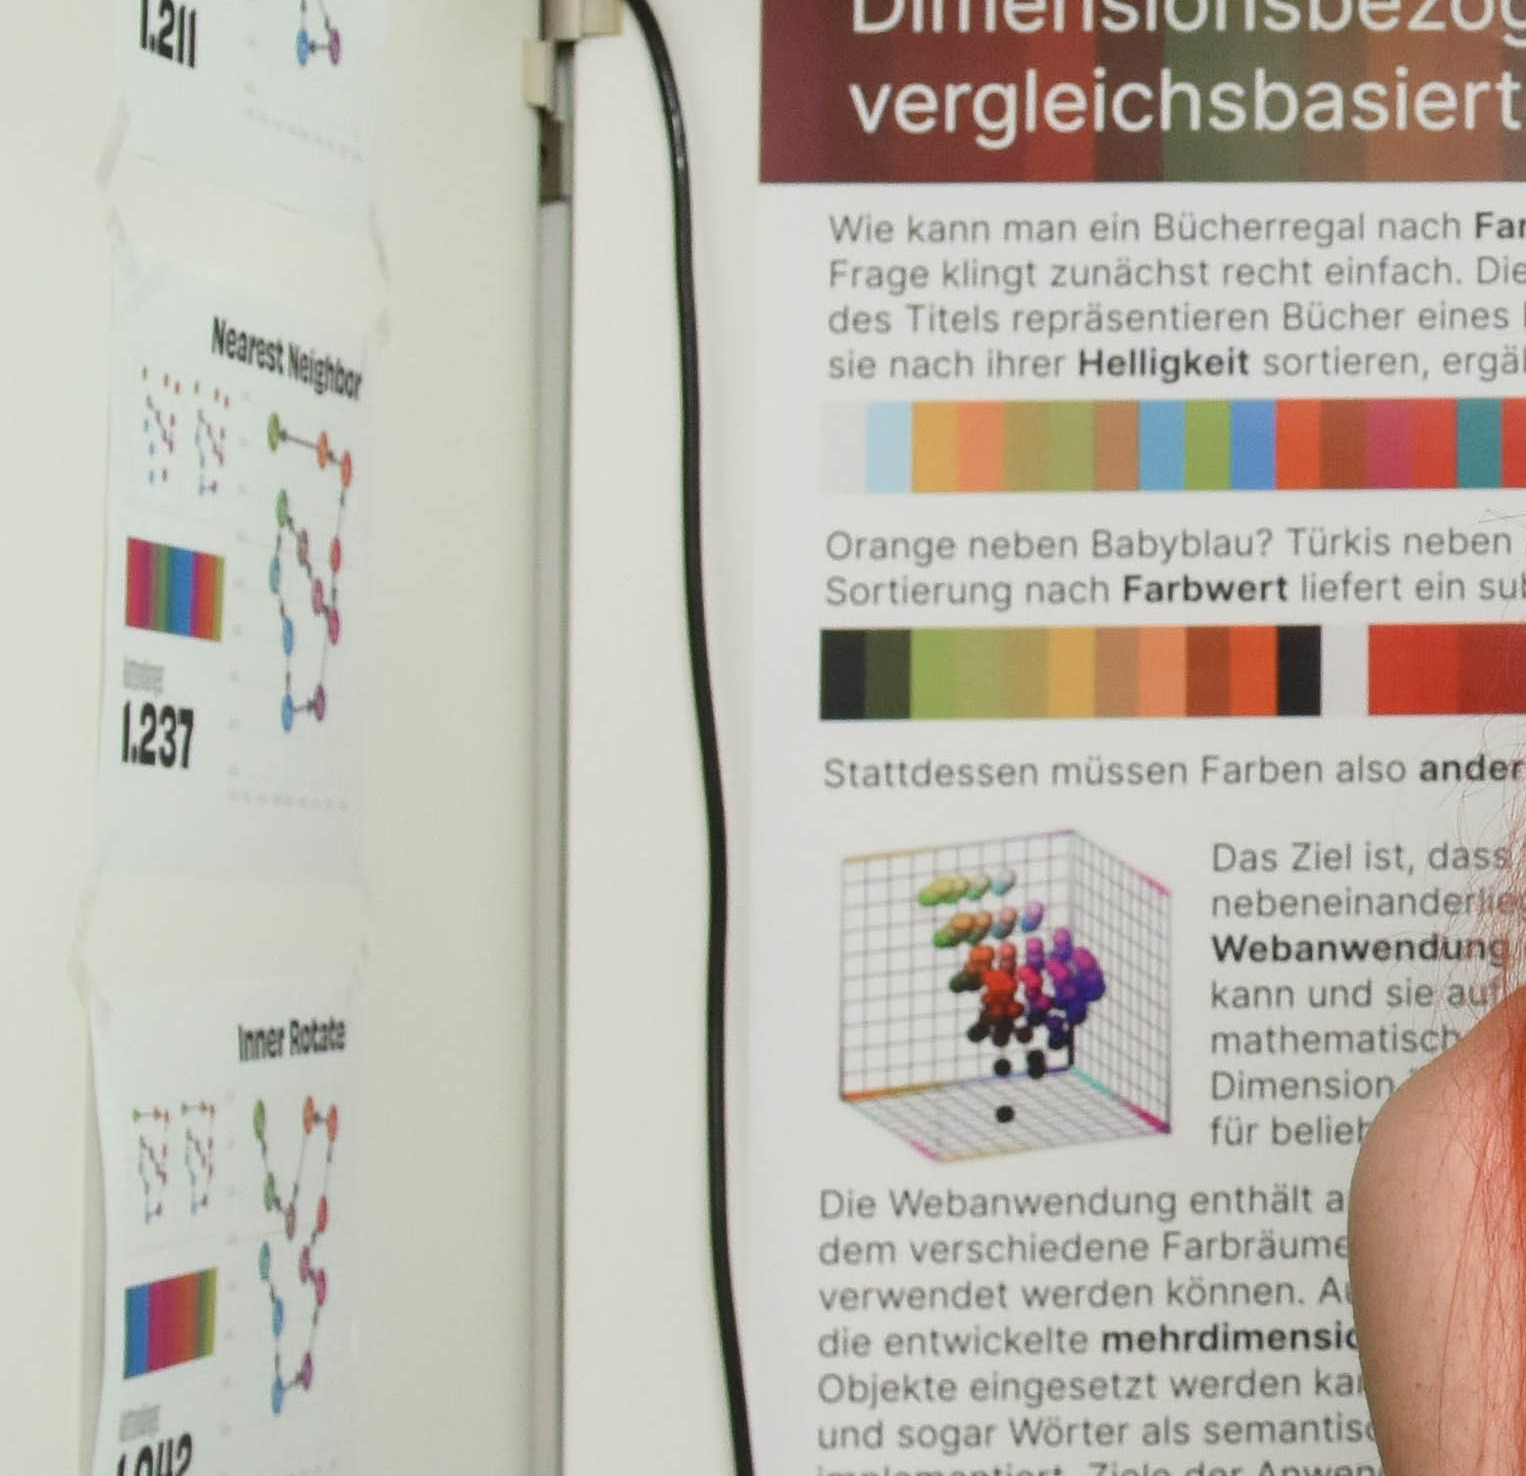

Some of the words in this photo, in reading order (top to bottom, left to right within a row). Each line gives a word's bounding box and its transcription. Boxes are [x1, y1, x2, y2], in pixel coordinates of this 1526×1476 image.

[829, 215, 894, 243] Wie
[907, 216, 990, 242] kann
[1004, 219, 1076, 243] man
[1089, 219, 1140, 241] ein
[1154, 212, 1364, 248] Bücherregal
[1378, 212, 1461, 240] nach
[829, 259, 930, 297] Frage
[942, 260, 1036, 296] klingt
[1050, 258, 1208, 289] zunächst
[1223, 257, 1312, 286] recht
[1325, 255, 1462, 286] einfach.
[828, 305, 892, 334] des
[906, 303, 1000, 334] Titels
[1012, 301, 1269, 339] repräsentieren
[1283, 301, 1405, 332] Bücher
[1417, 301, 1509, 331] eines
[211, 315, 284, 374] Nearest
[288, 348, 363, 401] Neighbor
[830, 354, 876, 378] sie
[890, 352, 973, 377] nach
[988, 352, 1063, 377] ihrer
[1079, 346, 1249, 385] Helligkeit
[1264, 350, 1428, 378] sortieren,
[826, 530, 956, 568] Orange
[969, 532, 1078, 560] neben
[1092, 527, 1273, 565] Babyblau?
[1287, 526, 1391, 558] Türkis
[1404, 527, 1512, 557] neben
[827, 580, 1011, 610] Sortierung
[1026, 577, 1109, 603] nach
[1123, 573, 1288, 603] Farbwert
[1302, 572, 1401, 601] liefert
[1415, 578, 1465, 601] ein
[825, 760, 1038, 787] Stattdessen
[1052, 762, 1187, 785] müssen
[1202, 755, 1323, 784] Farben
[1336, 755, 1406, 783] also
[1213, 842, 1278, 873] Das
[1291, 841, 1352, 872] Ziel
[1365, 841, 1414, 876] ist,
[1427, 839, 1512, 871] dass
[1212, 932, 1509, 968] Webanwendung
[1211, 981, 1295, 1009] kann
[1308, 979, 1372, 1009] und
[1386, 977, 1435, 1009] sie
[1446, 974, 1503, 1008] auf
[237, 1022, 284, 1062] Inner
[288, 1017, 347, 1056] Rotate
[1211, 1068, 1396, 1102] Dimension
[1211, 1115, 1258, 1147] für
[820, 1189, 876, 1219] Die
[889, 1187, 1177, 1223] Webanwendung
[1189, 1183, 1313, 1215] enthält
[1325, 1189, 1345, 1214] a
[819, 1237, 895, 1265] dem
[910, 1235, 1150, 1264] verschiedene
[1163, 1229, 1347, 1261] Farbräume
[819, 1282, 1007, 1310] verwendet
[1021, 1279, 1153, 1309] werden
[1167, 1275, 1305, 1307] können.
[818, 1329, 871, 1358] die
[884, 1325, 1089, 1357] entwickelte
[818, 1373, 957, 1408] Objekte
[970, 1373, 1155, 1409] eingesetzt
[1169, 1368, 1301, 1400] werden
[818, 1421, 883, 1449] und
[898, 1425, 995, 1455] sogar
[1009, 1418, 1128, 1447] Wörter
[1141, 1416, 1190, 1446] als
